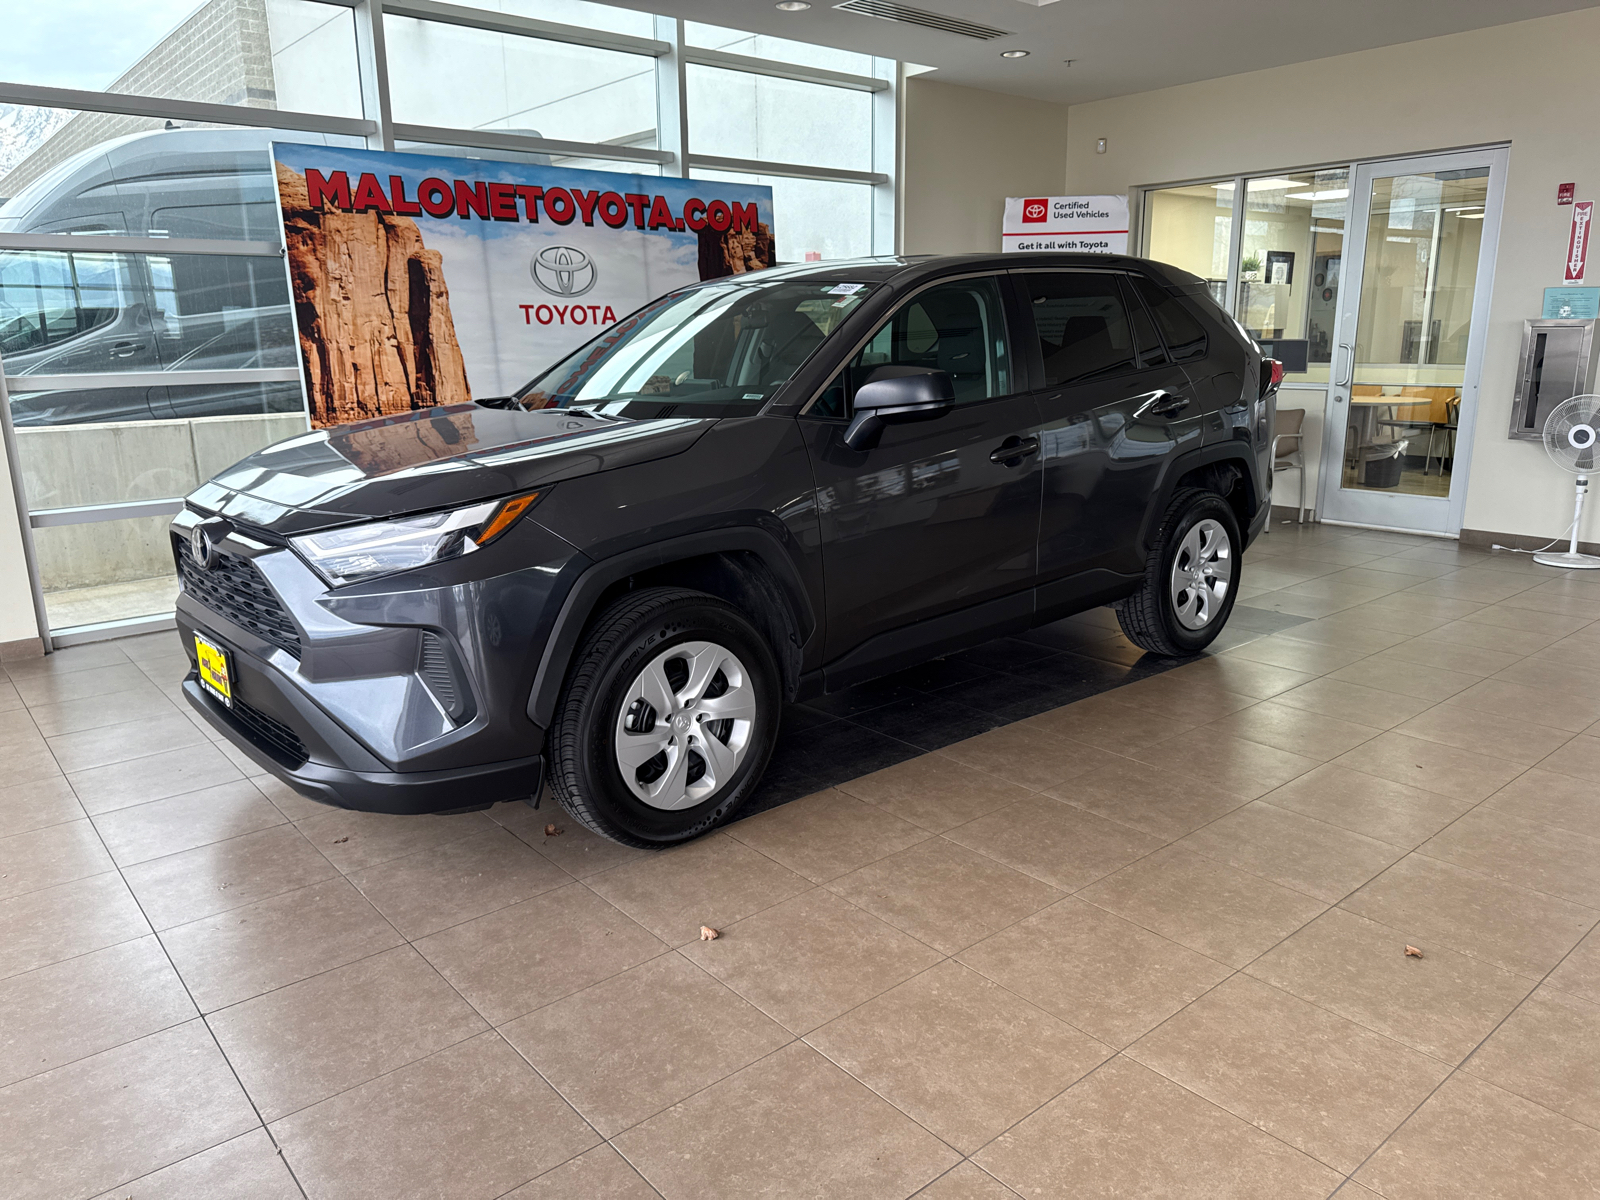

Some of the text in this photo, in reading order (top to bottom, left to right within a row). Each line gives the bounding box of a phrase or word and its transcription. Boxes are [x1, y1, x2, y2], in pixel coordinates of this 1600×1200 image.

[304, 168, 760, 234] MALONETOYOTA.COM
[1053, 201, 1090, 210] Certified
[1053, 210, 1110, 219] Used Vehicles
[1018, 242, 1035, 250] Get
[1057, 241, 1078, 249] with
[1079, 240, 1109, 250] Toyota
[1573, 217, 1584, 272] EXTINGUISHER
[519, 304, 617, 325] TOYOTA
